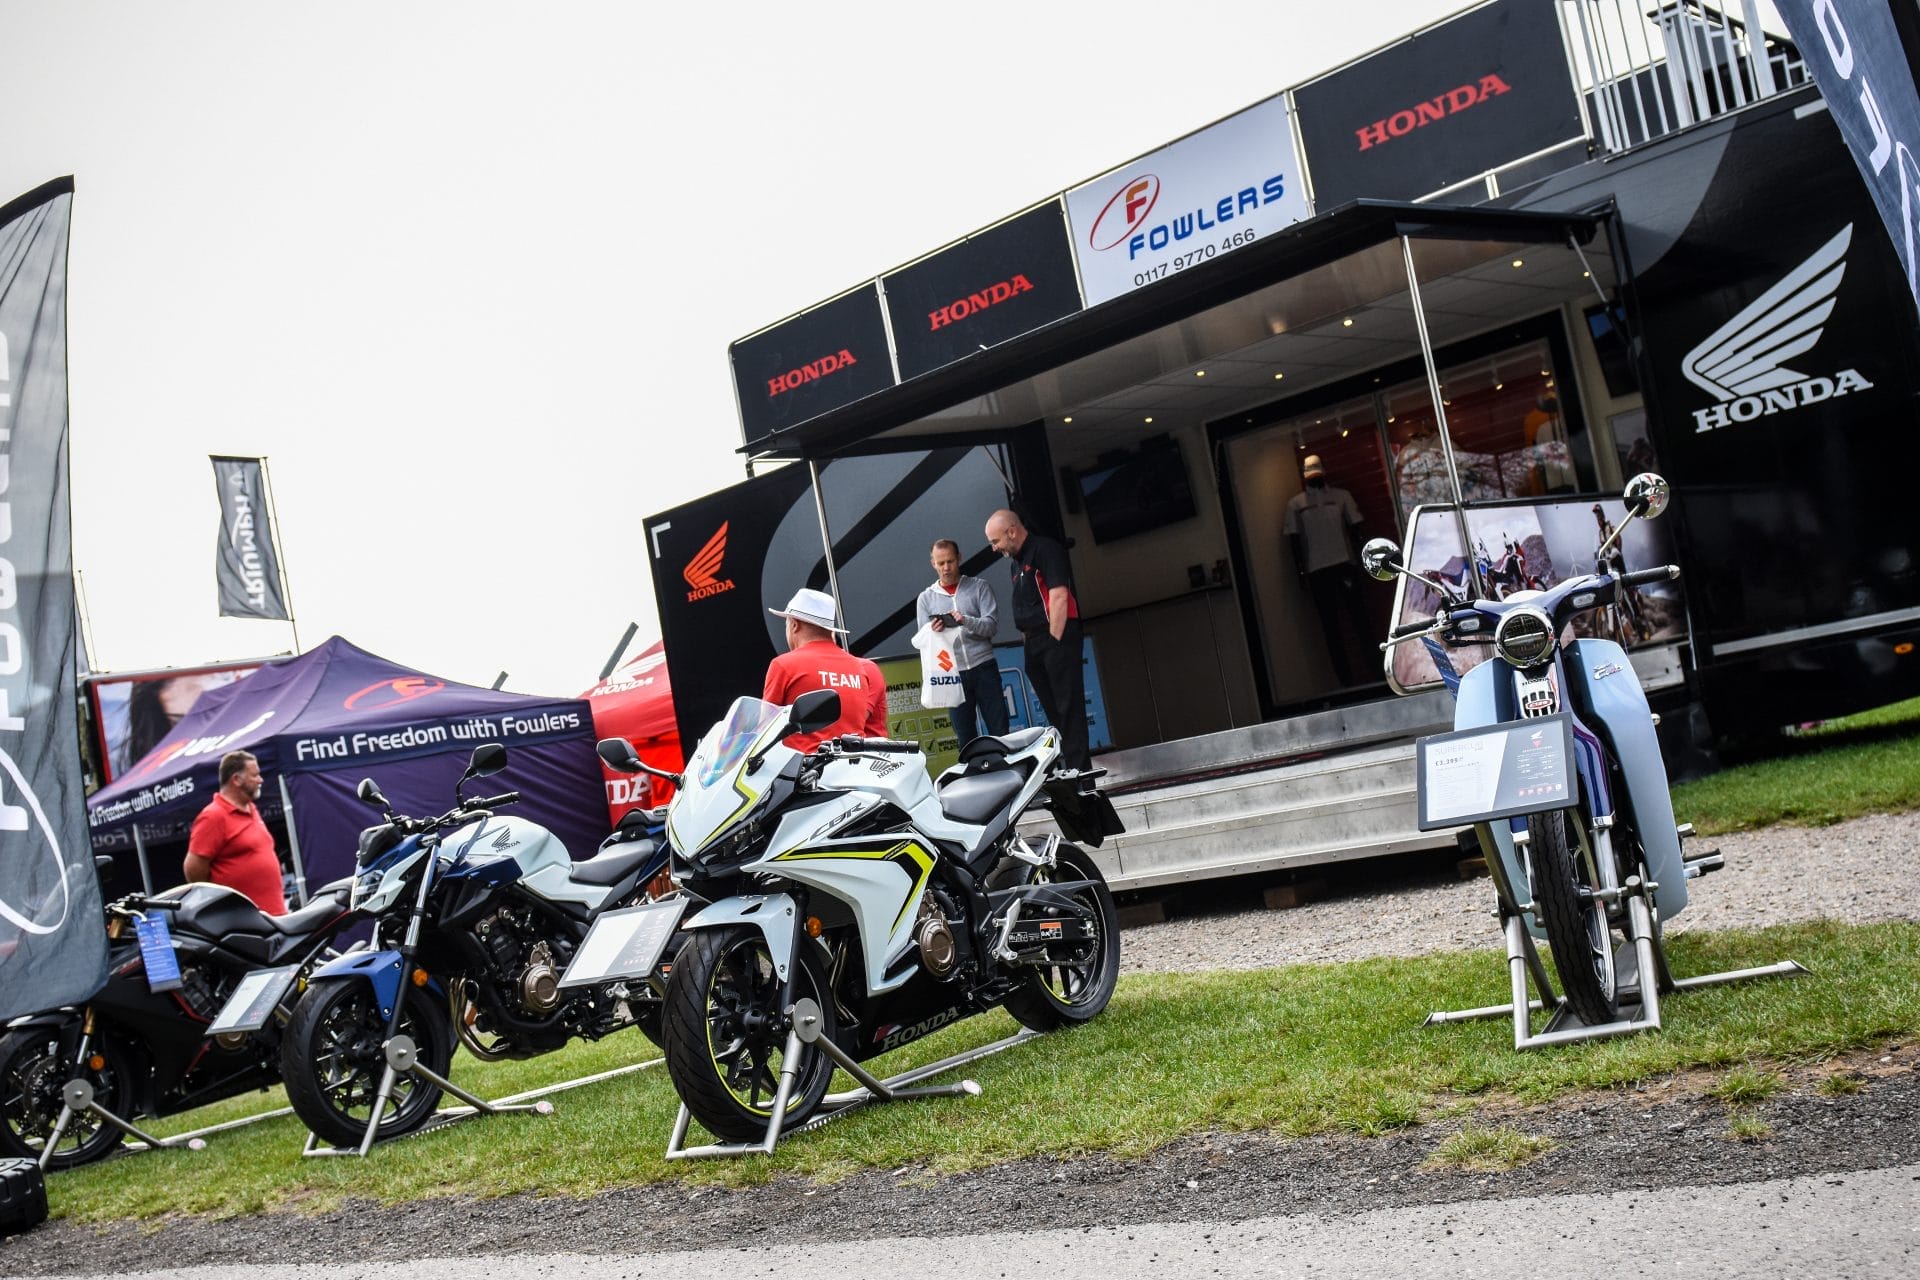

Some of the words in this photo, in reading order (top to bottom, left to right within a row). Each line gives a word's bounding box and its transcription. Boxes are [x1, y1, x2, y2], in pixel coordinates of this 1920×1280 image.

[1355, 73, 1512, 151] HONDA
[1129, 174, 1284, 260] FOWLERS
[1134, 263, 1168, 286] 0117
[1174, 244, 1216, 271] 9770
[1222, 228, 1255, 251] 466
[928, 274, 1034, 331] HONDA
[768, 349, 857, 397] HONDA
[1692, 368, 1874, 433] HONDA
[688, 579, 736, 602] HONDA
[590, 677, 654, 697] HONDA
[818, 671, 861, 689] TEAM
[296, 736, 349, 761] Find
[352, 726, 447, 754] Freedom
[450, 718, 497, 739] with
[502, 713, 580, 736] Fowlers
[131, 789, 154, 812] with
[154, 777, 194, 805] Fowlers
[810, 803, 866, 841] CBR
[880, 1006, 960, 1052] HONDA
